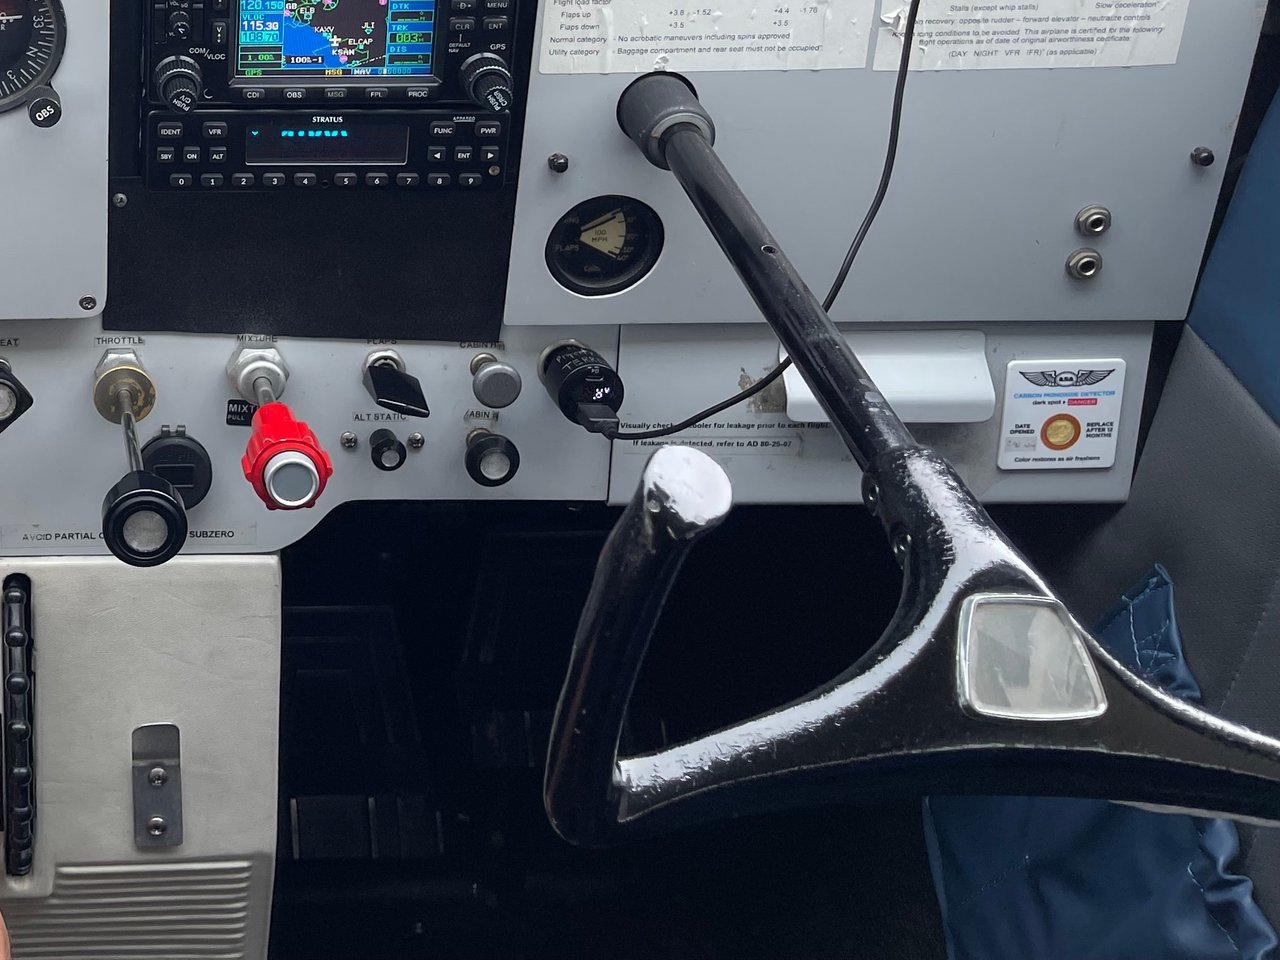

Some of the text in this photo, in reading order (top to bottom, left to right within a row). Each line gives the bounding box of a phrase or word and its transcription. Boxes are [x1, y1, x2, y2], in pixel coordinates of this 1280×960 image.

[243, 21, 279, 30] 115.30
[35, 106, 55, 121] OBS
[96, 337, 144, 345] THROTTLE
[236, 335, 278, 343] MIXTURE
[354, 413, 407, 421] ALT STATIC
[55, 532, 96, 541] PARTIAL
[189, 530, 235, 539] SUBZERO
